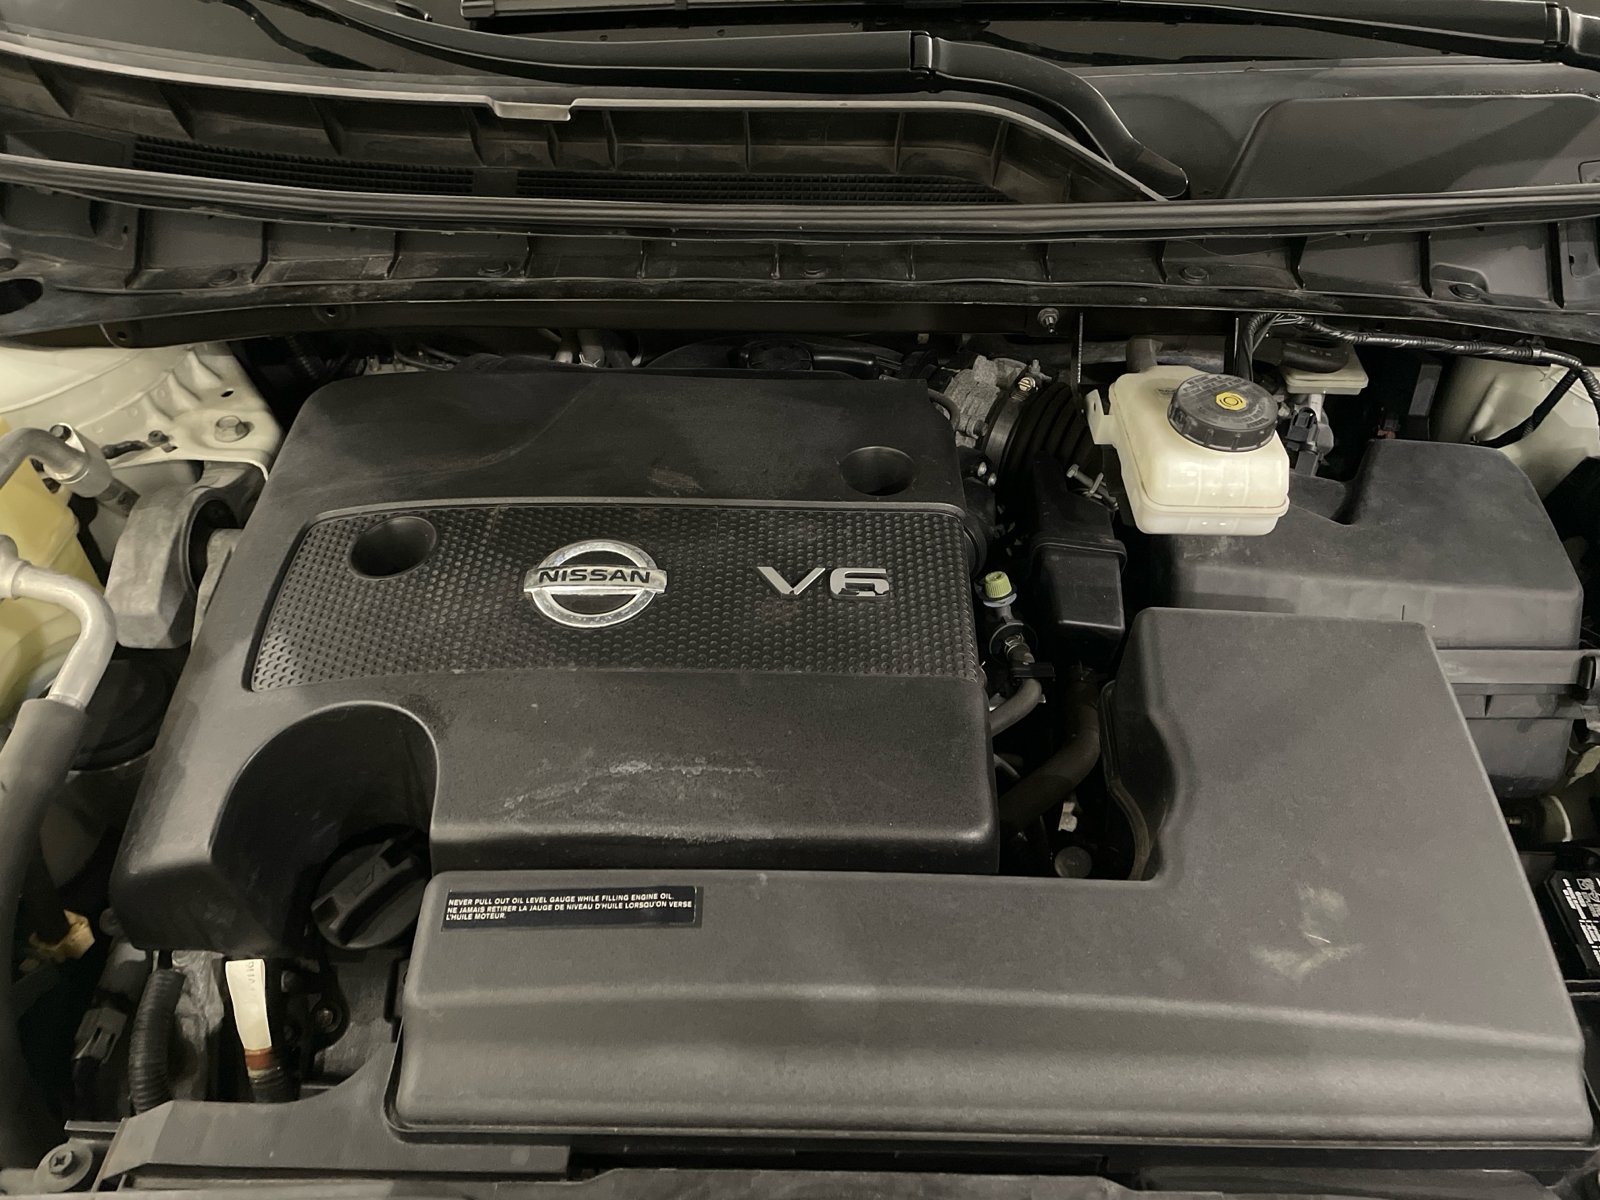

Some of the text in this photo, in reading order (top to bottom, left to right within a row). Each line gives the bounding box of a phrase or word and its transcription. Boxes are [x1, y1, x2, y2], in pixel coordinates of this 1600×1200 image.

[538, 569, 651, 584] NISSAN
[757, 566, 890, 598] V6
[601, 894, 629, 902] FILLING
[631, 893, 658, 901] ENGINE
[625, 901, 667, 909] LORSQU'ON
